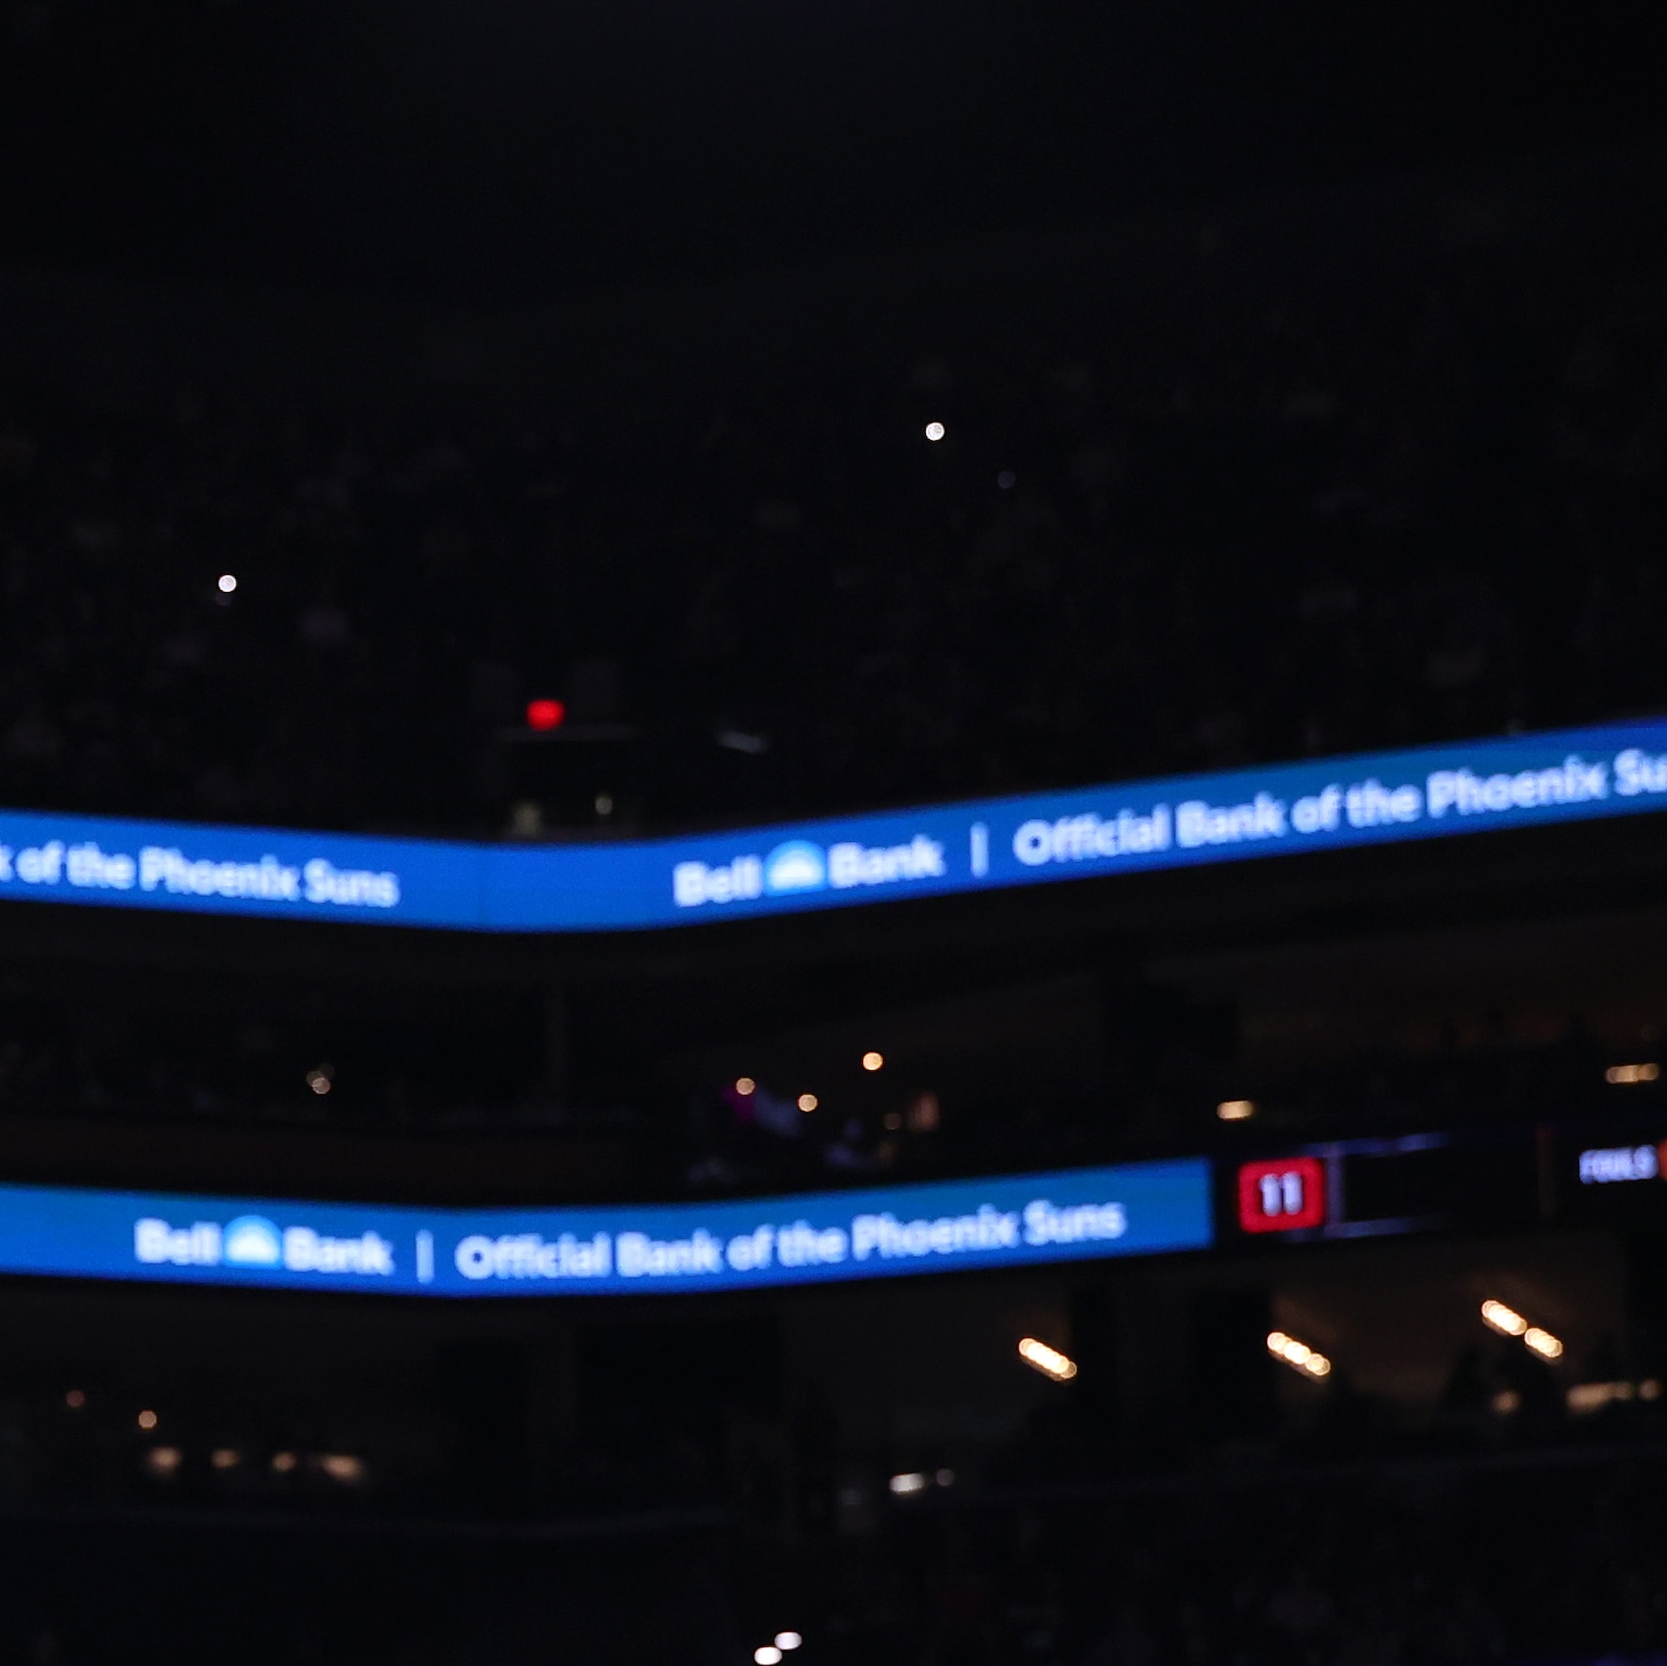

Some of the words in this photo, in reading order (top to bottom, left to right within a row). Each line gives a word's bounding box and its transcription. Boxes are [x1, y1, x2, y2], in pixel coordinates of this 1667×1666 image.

[674, 858, 762, 907] Bell
[828, 839, 941, 887] Bank
[1014, 810, 1169, 864] Official
[1176, 798, 1282, 846] Bank
[1293, 789, 1341, 831] of
[1346, 786, 1418, 824] the
[1428, 764, 1605, 812] Phoenix
[1616, 751, 1667, 794] Su
[17, 844, 62, 882] of
[67, 848, 134, 887] the
[140, 848, 297, 897] Phoenix
[305, 861, 396, 905] Suns
[1259, 1170, 1304, 1218] 11
[135, 1219, 221, 1264] Bell
[283, 1227, 391, 1272] Bank
[456, 1237, 611, 1279] Official
[617, 1233, 720, 1276] Bank
[727, 1229, 773, 1268] of
[777, 1227, 845, 1264] the
[852, 1213, 1016, 1255] Phoenix
[1026, 1202, 1122, 1243] Suns
